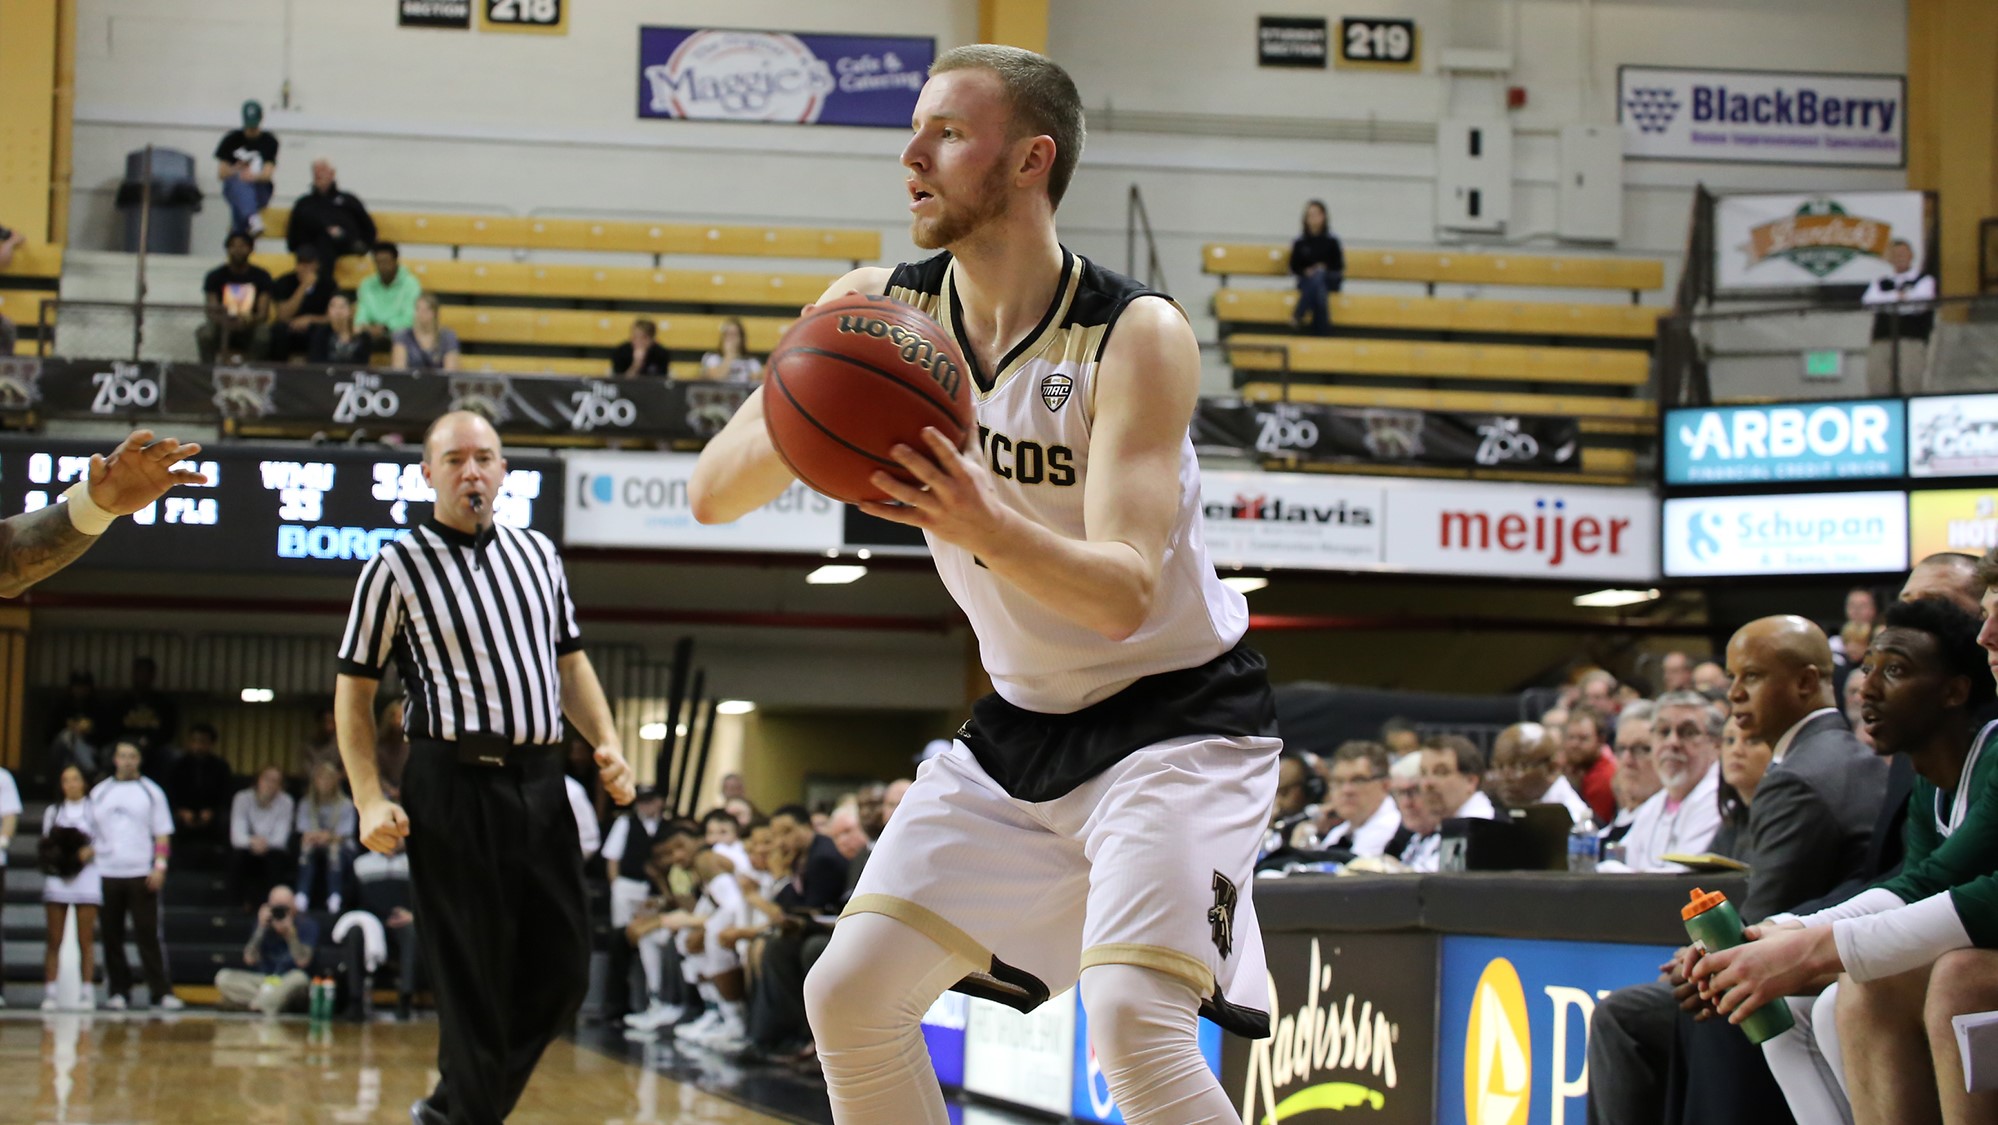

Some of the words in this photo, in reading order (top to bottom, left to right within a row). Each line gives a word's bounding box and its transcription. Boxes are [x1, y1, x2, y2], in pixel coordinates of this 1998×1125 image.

[490, 0, 556, 22] 218
[1347, 22, 1411, 60] 219
[1691, 84, 1898, 134] BlackBerry
[836, 314, 962, 403] Wilson
[1043, 385, 1070, 396] MAC
[1689, 405, 1889, 460] ARBOR
[277, 523, 412, 559] BORG
[1440, 499, 1630, 566] meijer
[1737, 512, 1885, 543] Schupan
[1243, 937, 1398, 1125] Radisson
